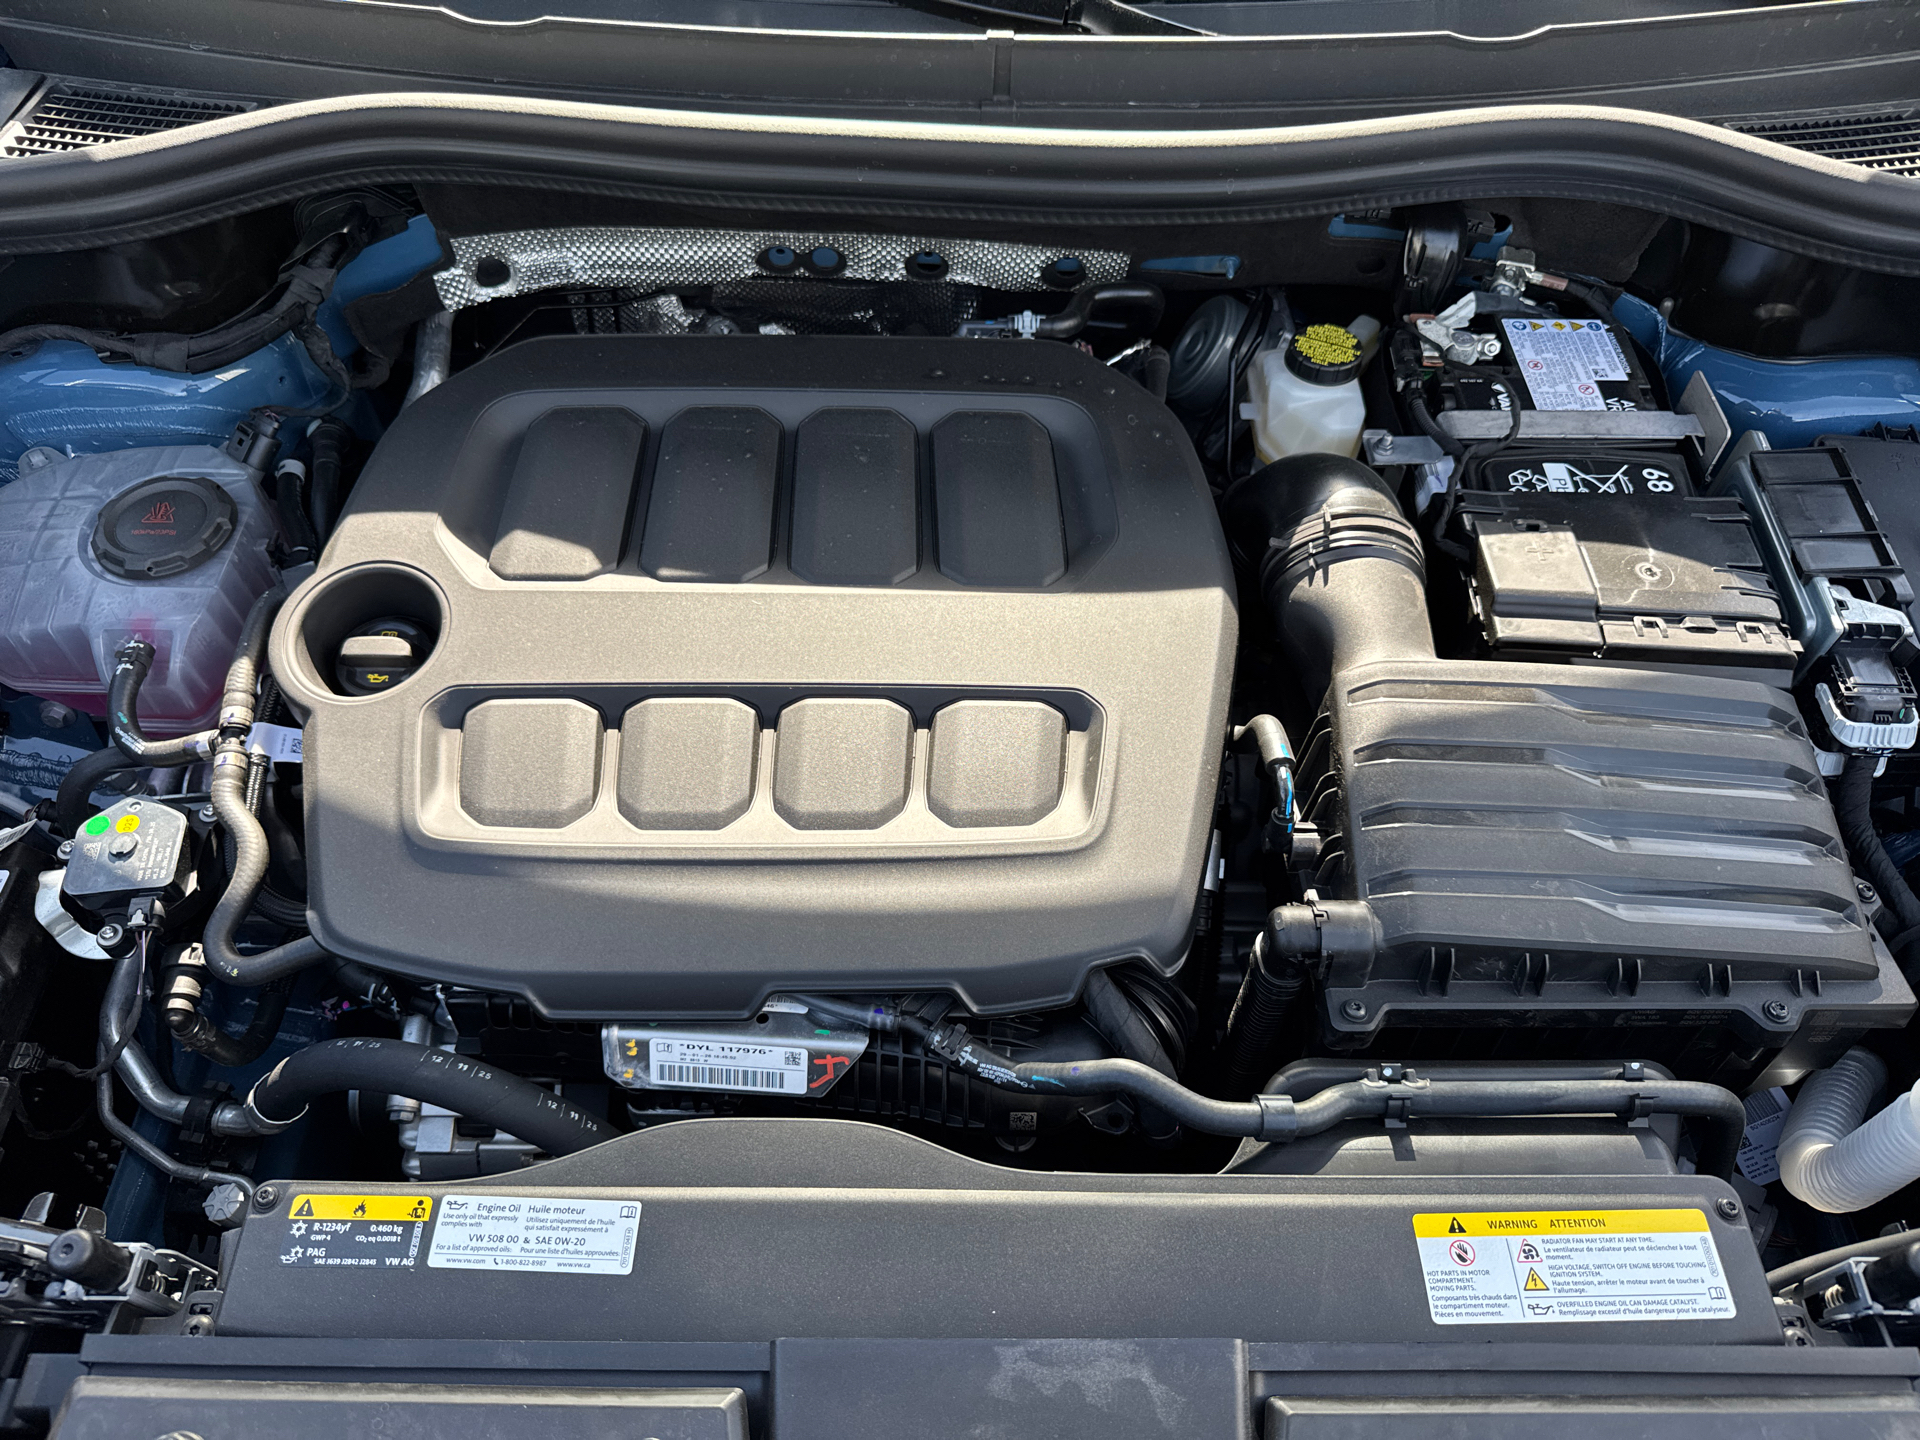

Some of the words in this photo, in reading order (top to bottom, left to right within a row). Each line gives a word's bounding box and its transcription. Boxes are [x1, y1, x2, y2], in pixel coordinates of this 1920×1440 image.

[1642, 468, 1675, 492] 68
[477, 1070, 492, 1080] 25
[546, 1100, 558, 1109] 12
[477, 1203, 507, 1213] Engine
[508, 1204, 521, 1212] Oil
[528, 1205, 551, 1214] Huile
[553, 1206, 585, 1214] moteur
[491, 1215, 518, 1223] expressly
[313, 1222, 351, 1233] R-1234yf
[393, 1225, 403, 1234] kg
[1486, 1218, 1538, 1230] WARNING
[1549, 1218, 1606, 1229] ATTENTION
[469, 1234, 485, 1242] VW
[487, 1235, 504, 1243] 508
[506, 1235, 519, 1243] 00
[535, 1236, 553, 1245] SAE
[554, 1237, 586, 1246] 0W-20
[306, 1248, 326, 1256] PAG
[469, 1245, 498, 1253] approved
[401, 1258, 415, 1266] AG
[1557, 1300, 1593, 1308] OVERFILLED
[1559, 1309, 1597, 1317] Remplissage
[1622, 1307, 1643, 1315] d'huile
[1644, 1307, 1675, 1315] dangereux
[1698, 1306, 1730, 1314] catalyseur.
